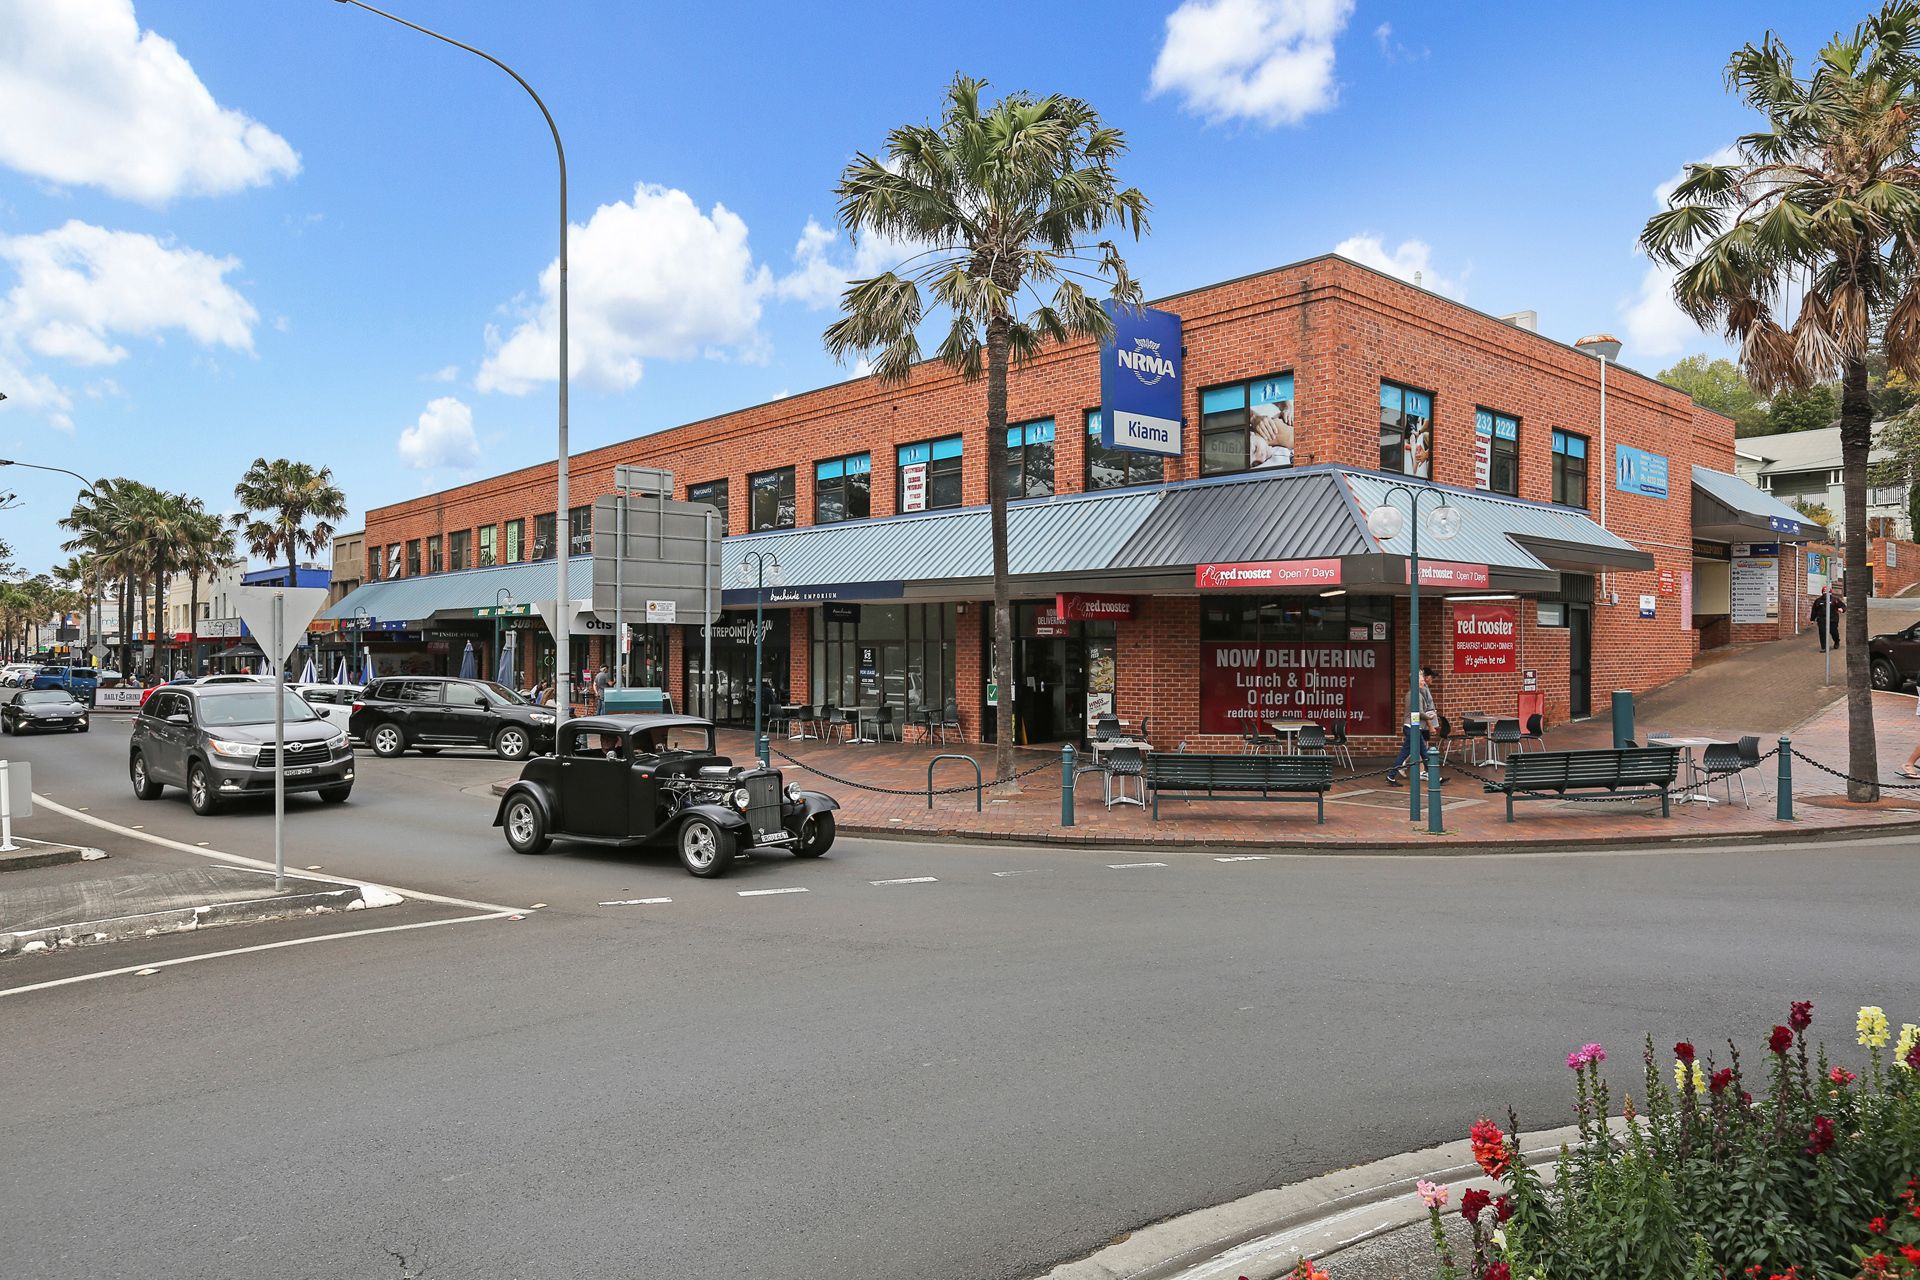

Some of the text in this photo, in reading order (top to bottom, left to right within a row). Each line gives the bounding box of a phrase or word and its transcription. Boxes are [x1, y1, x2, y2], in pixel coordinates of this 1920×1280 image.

[1118, 349, 1176, 378] NRMA
[1128, 420, 1168, 442] Kiama
[1496, 419, 1516, 438] 2222
[1220, 568, 1335, 580] red rooster Open 7 Days
[1422, 566, 1432, 578] red
[1432, 568, 1453, 579] rooster
[1456, 572, 1469, 581] Open
[1474, 572, 1486, 583] Days
[804, 592, 837, 600] EMPORIUM
[1085, 600, 1130, 613] red rooster
[510, 619, 548, 629] SUBWA
[586, 619, 612, 630] otis
[1457, 614, 1513, 635] red rooster
[700, 620, 773, 645] CTREPOINT Piza
[1457, 642, 1480, 650] BREAKFAST
[1216, 649, 1375, 668] NOW DELIVERING
[1489, 655, 1496, 664] be
[1496, 655, 1506, 664] red
[1236, 672, 1355, 687] Lunch & Dinner
[1248, 690, 1344, 705] Order Online
[1228, 709, 1364, 721] redroostercom.au/delivery
